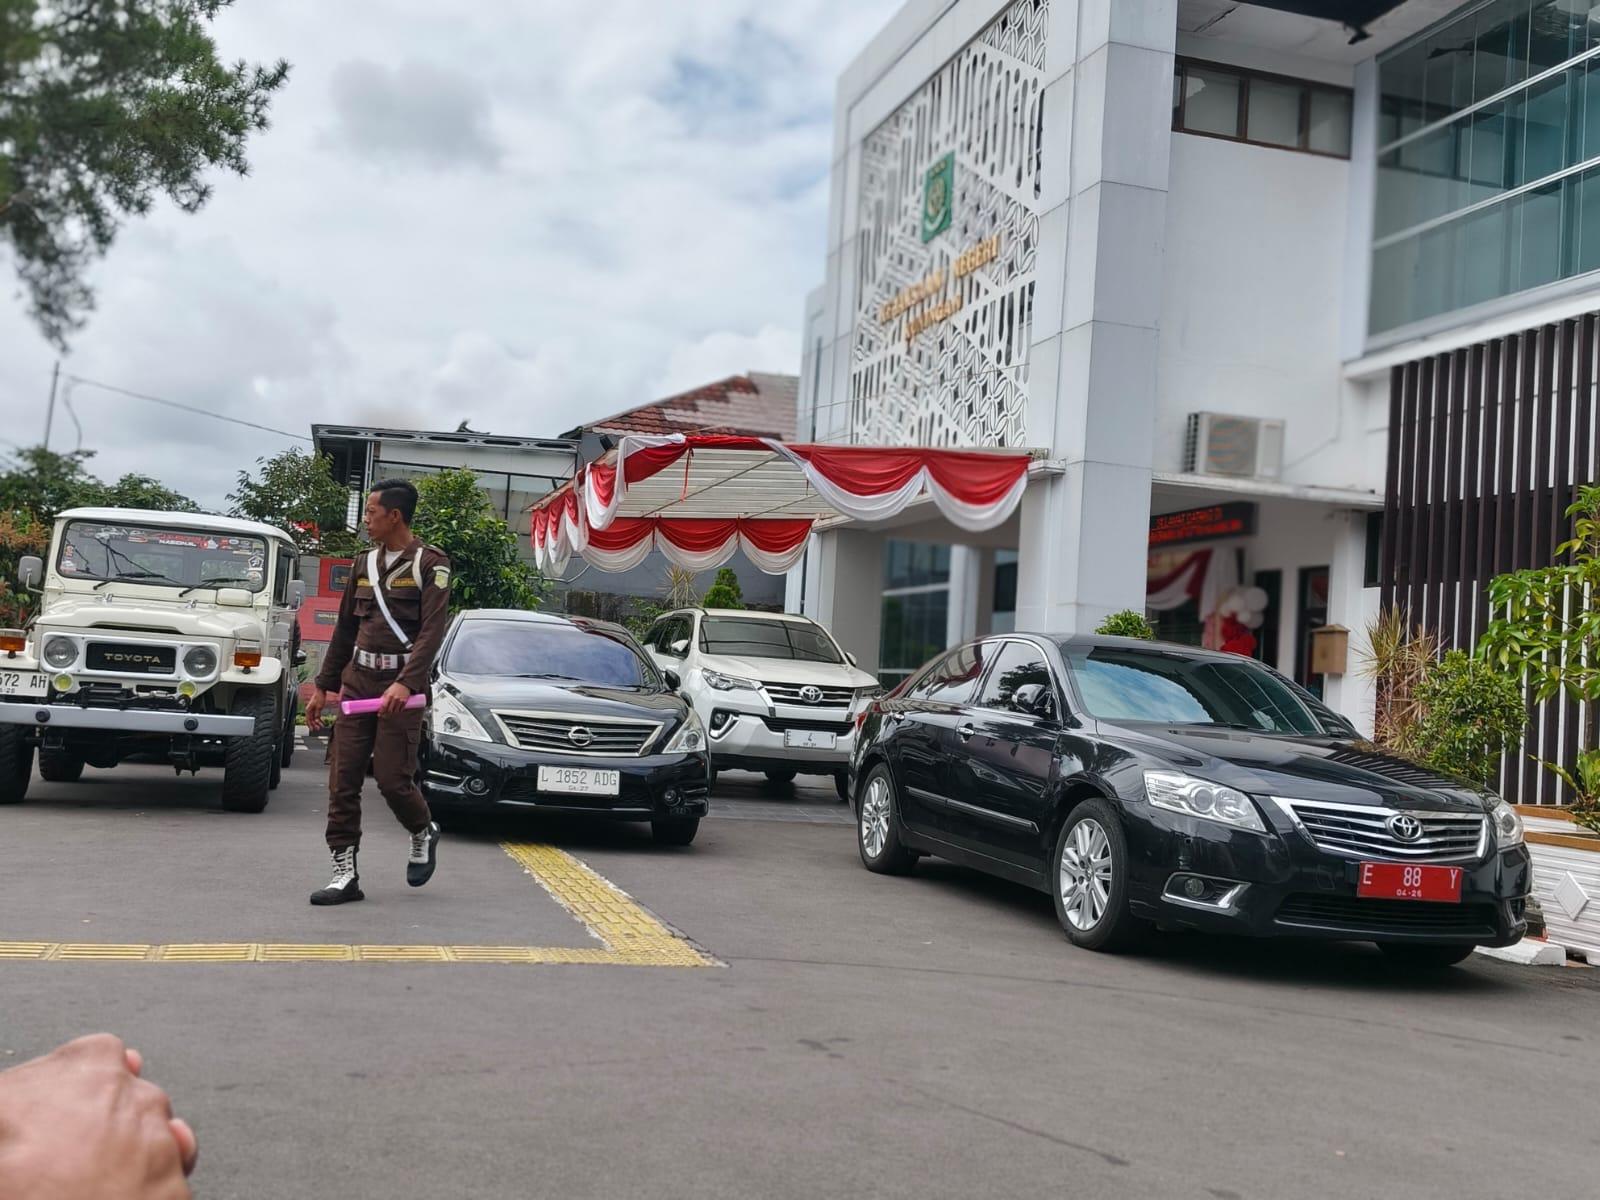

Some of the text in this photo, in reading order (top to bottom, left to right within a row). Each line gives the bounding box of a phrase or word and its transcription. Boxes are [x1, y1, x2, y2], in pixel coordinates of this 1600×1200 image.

[955, 234, 999, 278] NEGERI
[104, 653, 161, 664] TOYOTA
[30, 674, 48, 689] AH
[786, 730, 792, 741] E
[541, 768, 617, 786] L 1852 ADG
[1363, 864, 1459, 889] E 88 Y
